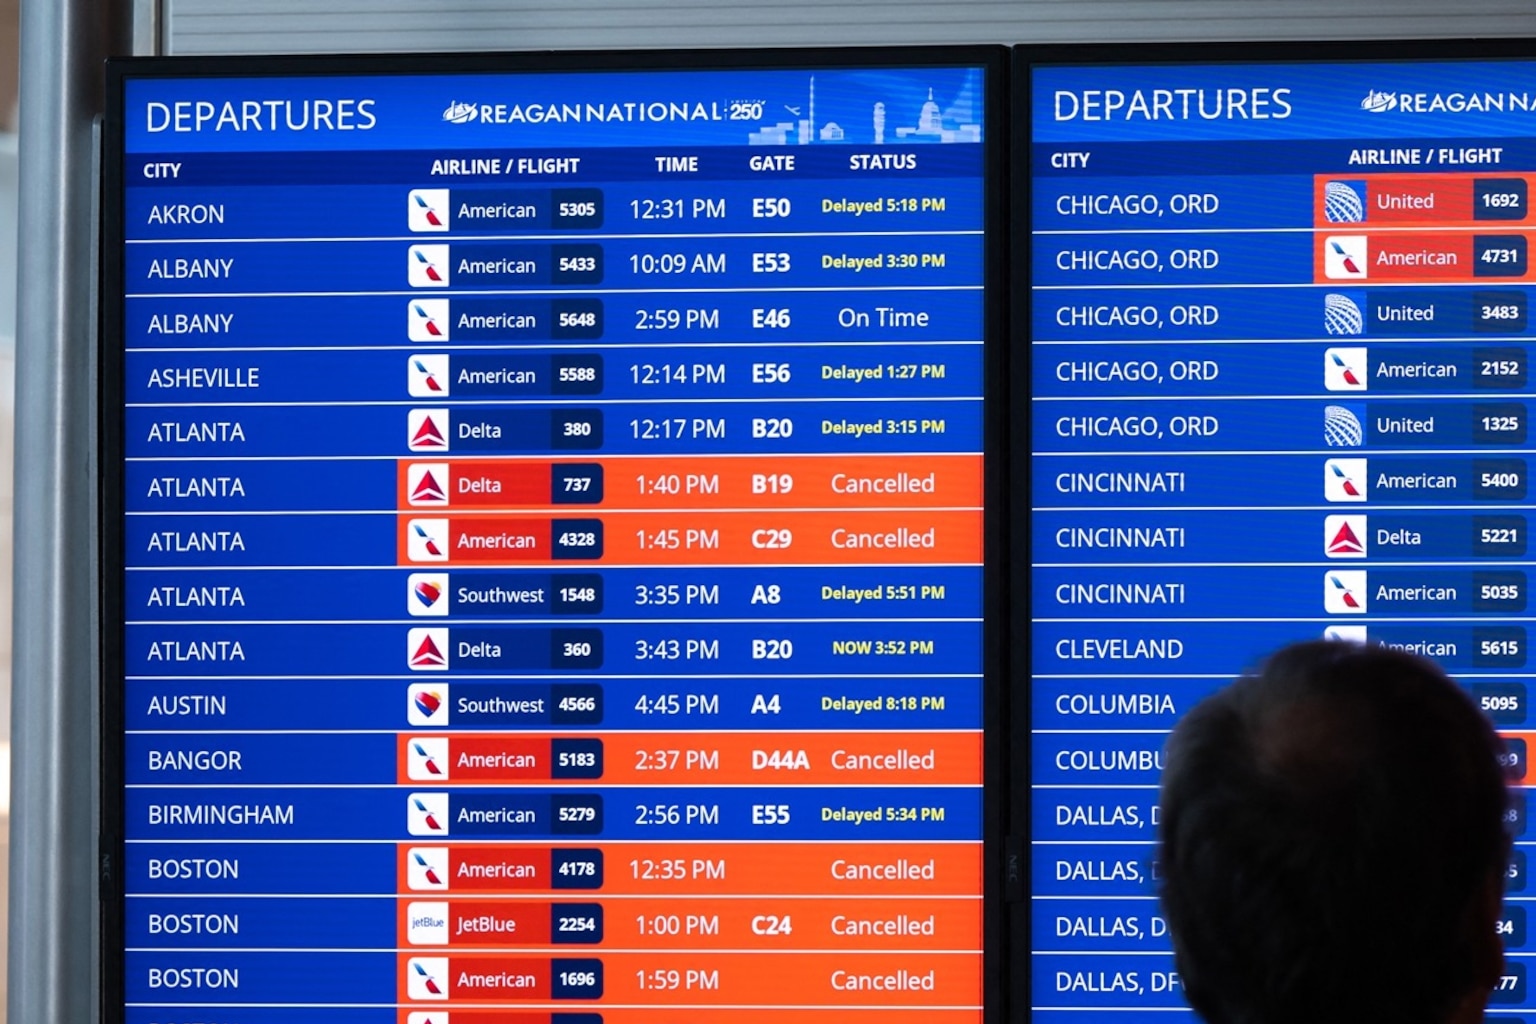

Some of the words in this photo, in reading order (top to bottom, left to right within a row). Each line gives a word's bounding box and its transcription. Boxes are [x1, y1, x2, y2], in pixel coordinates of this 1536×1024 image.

[480, 103, 581, 124] REAGAN
[586, 101, 722, 122] NATIONAL
[729, 103, 763, 121] 250
[1054, 88, 1292, 121] DEPARTURES
[1399, 92, 1504, 113] REAGAN
[147, 99, 377, 133] DEPARTURES
[143, 162, 182, 179] CITY
[430, 158, 501, 176] AIRLINE
[518, 157, 581, 174] FLIGHT
[654, 156, 698, 173] TIME
[749, 155, 795, 171] GATE
[849, 153, 917, 170] STATUS
[1050, 152, 1091, 168] CITY
[1348, 148, 1421, 165] AIRLINE
[1438, 147, 1503, 164] FLIGHT
[147, 204, 224, 225] AKRON
[457, 202, 536, 219] American
[559, 202, 596, 217] 5305
[630, 199, 683, 219] 12:31
[692, 198, 726, 219] PM
[752, 197, 791, 218] E50
[821, 197, 883, 217] Delayed
[886, 198, 918, 212] 5:18
[921, 197, 946, 212] PM
[1056, 194, 1164, 217] CHICAGO,
[1169, 193, 1219, 214] ORD
[1377, 192, 1434, 210] United
[1482, 193, 1519, 208] 1692
[1055, 527, 1185, 548] CINCINNATI
[1377, 528, 1421, 545] Delta
[1481, 528, 1517, 543] 5221
[147, 586, 245, 607] ATLANTA
[458, 586, 545, 604] Southwest
[559, 587, 596, 602] 1548
[635, 584, 680, 605] 3:35
[686, 584, 719, 605] PM
[750, 584, 781, 605] A8
[821, 584, 883, 604] Delayed
[886, 585, 916, 600] 5:51
[921, 585, 945, 600] PM
[1055, 694, 1176, 715] COLUMBIA
[1481, 696, 1519, 711] 5095
[148, 750, 242, 771] BANGOR
[457, 752, 536, 768] American
[559, 752, 595, 767] 5183
[634, 749, 680, 770] 2:37
[686, 749, 719, 770] PM
[752, 749, 811, 770] D44A
[831, 749, 935, 770] Cancelled
[148, 914, 239, 934] BOSTON
[455, 915, 516, 936] JetBlue
[558, 917, 596, 932] 2254
[636, 915, 681, 935] 1:00
[686, 915, 719, 935] PM
[751, 915, 793, 935] C24
[830, 914, 935, 936] Cancelled
[411, 917, 445, 929] jetBlue
